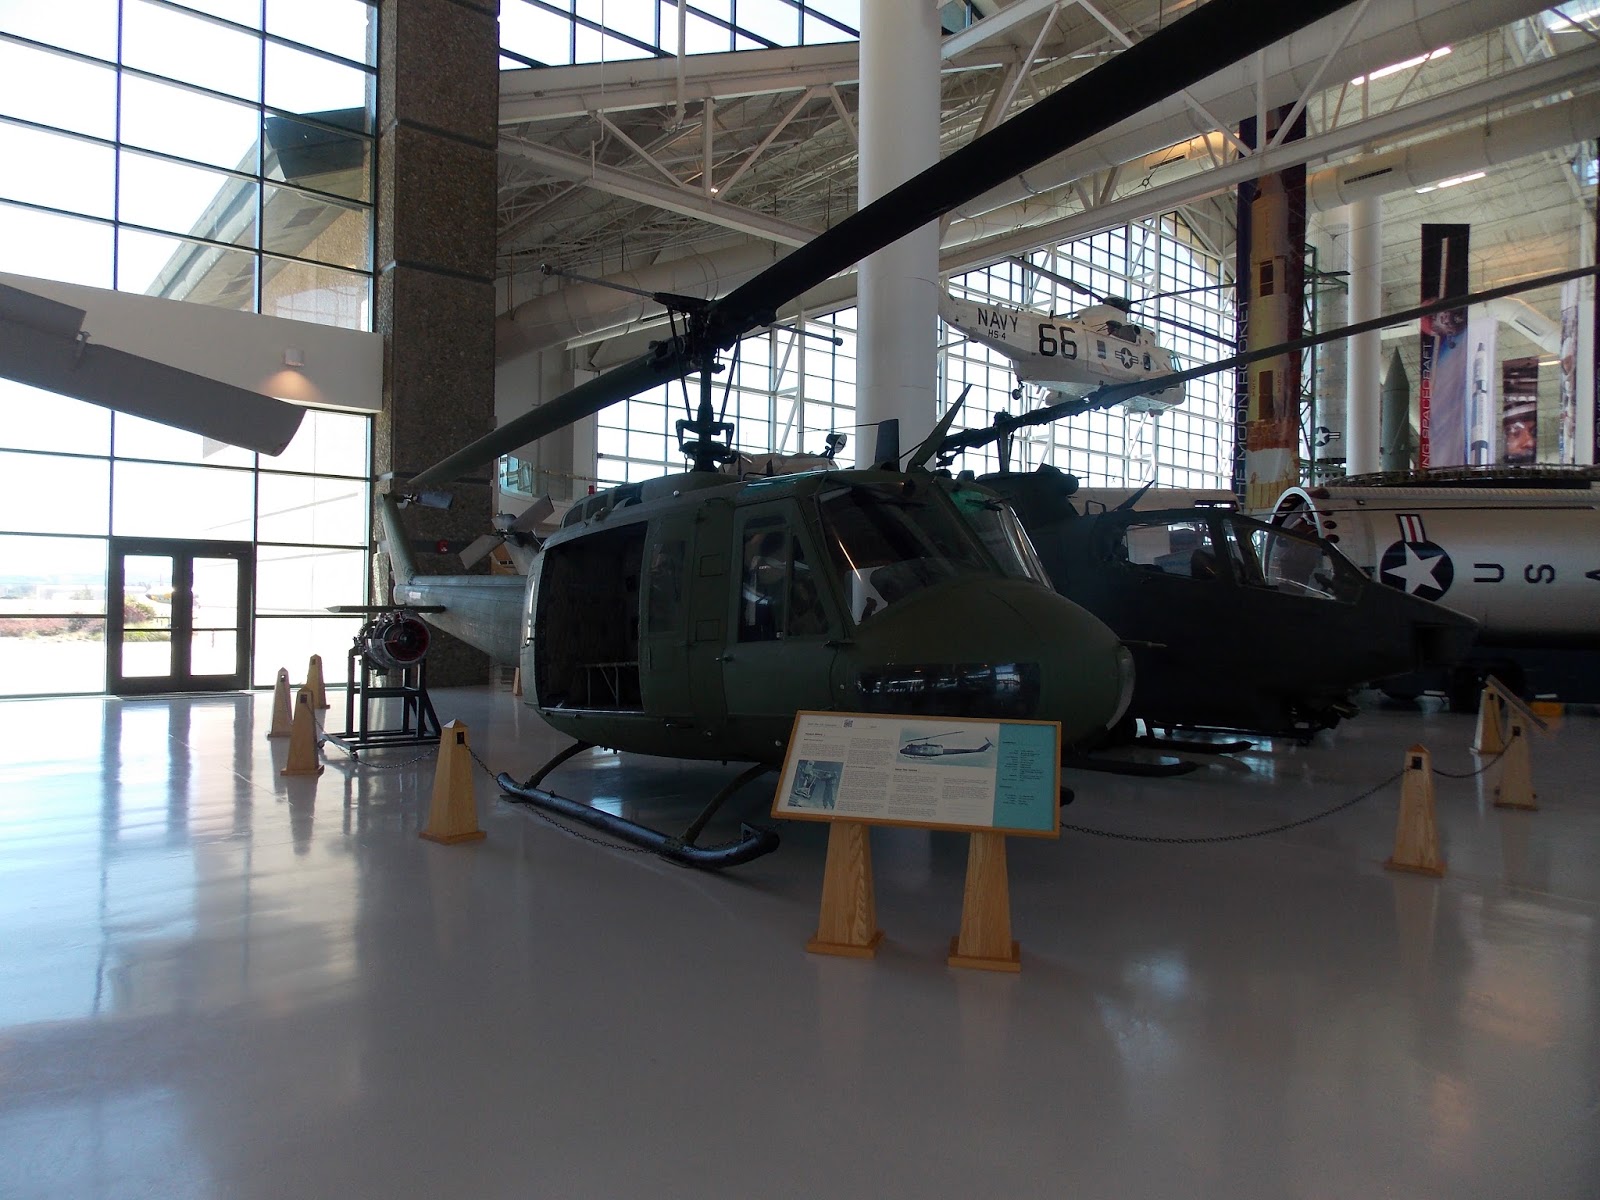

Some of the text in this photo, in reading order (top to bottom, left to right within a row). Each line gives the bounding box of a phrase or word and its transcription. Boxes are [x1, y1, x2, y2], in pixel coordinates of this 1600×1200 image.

[977, 307, 1018, 333] NAVY
[1038, 323, 1077, 360] 66
[1236, 393, 1248, 461] MOON
[1421, 341, 1431, 469] ING SPACECRAFT
